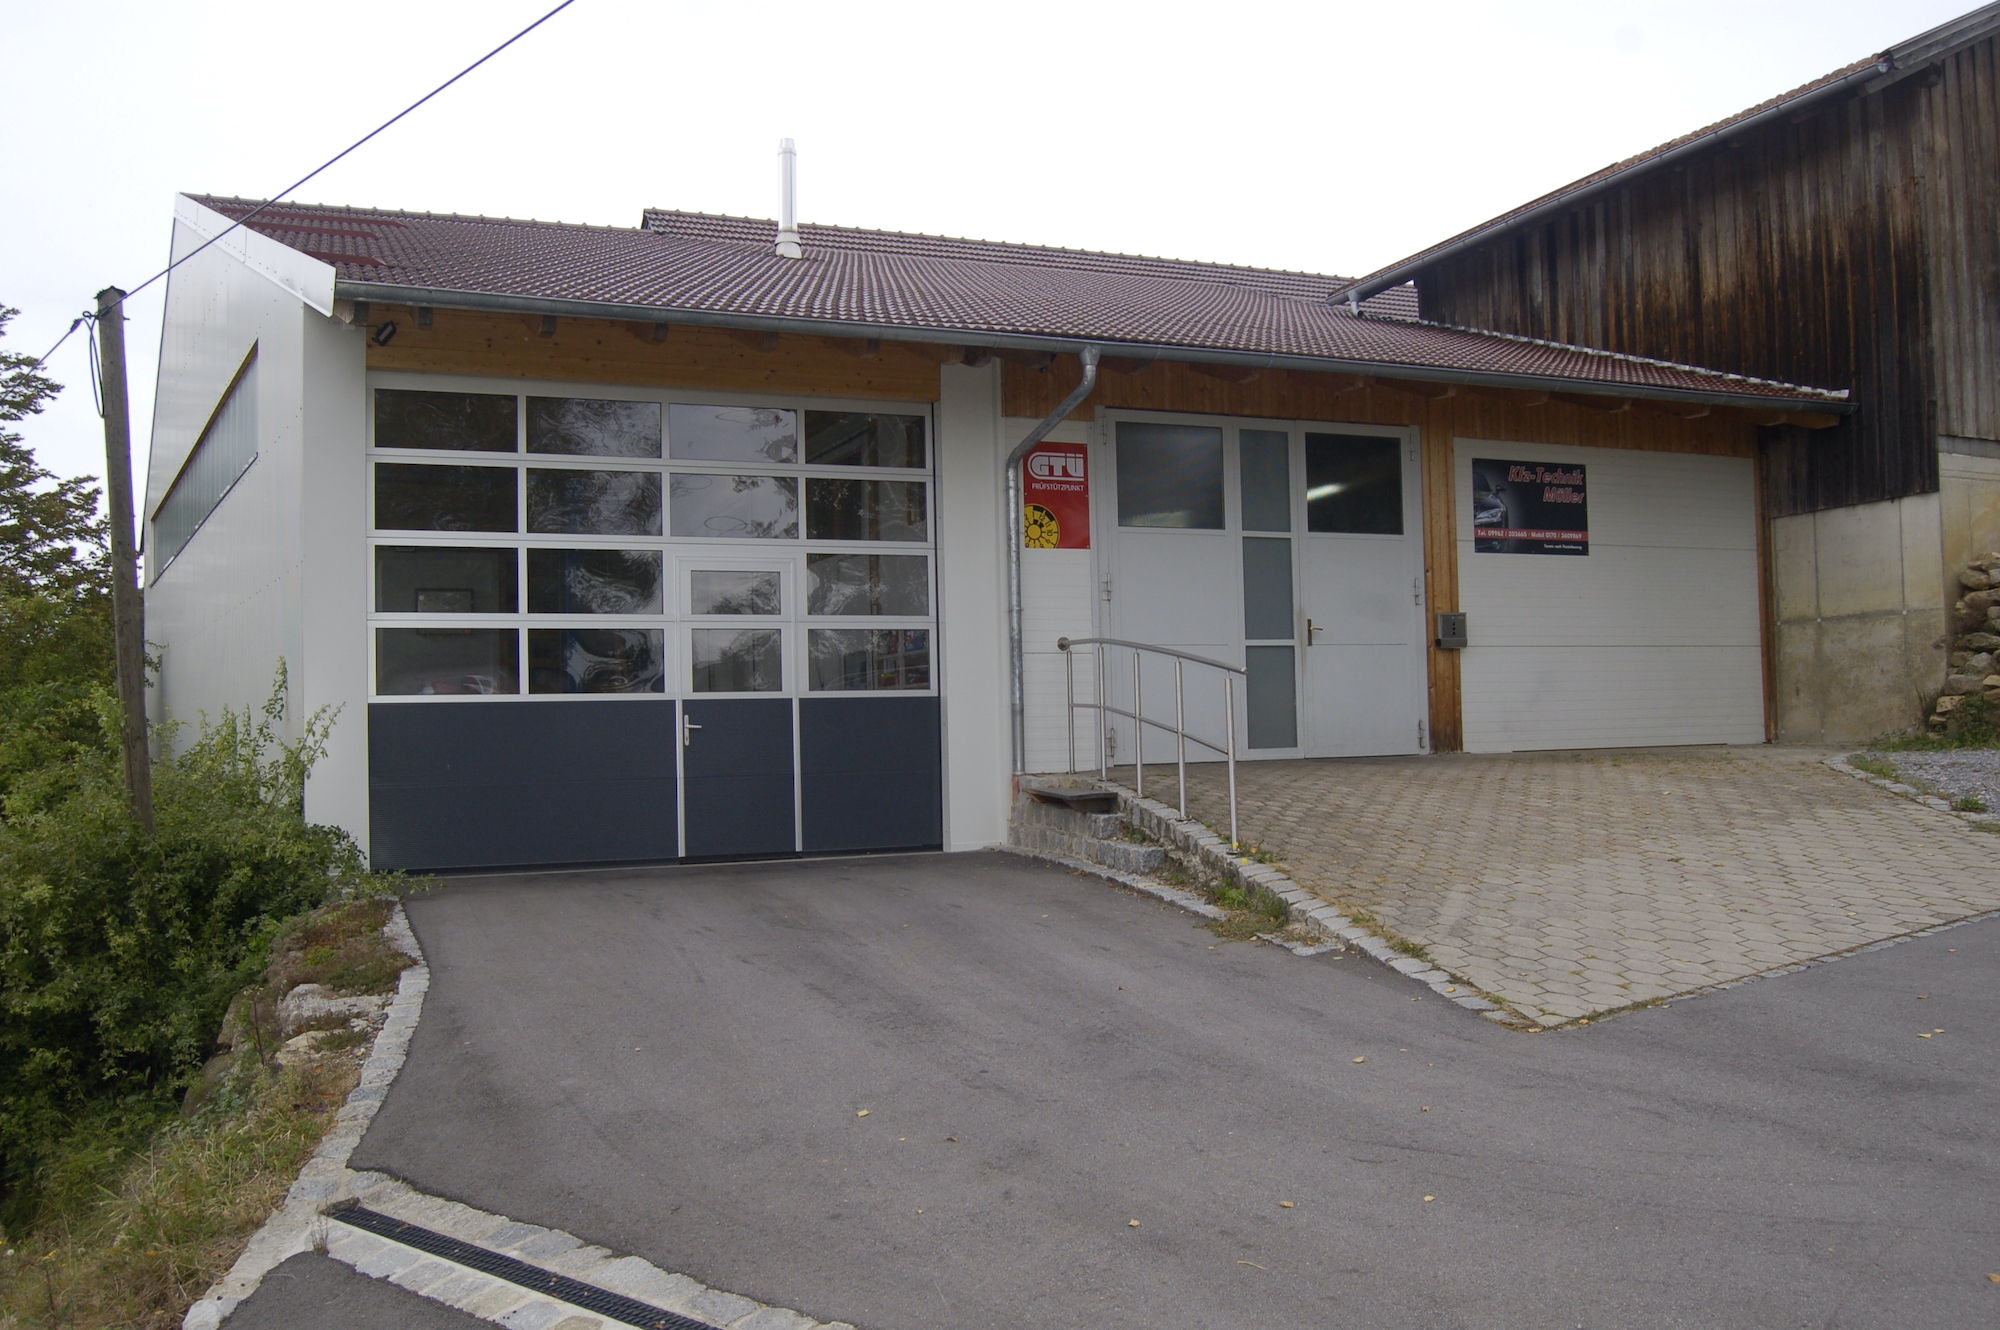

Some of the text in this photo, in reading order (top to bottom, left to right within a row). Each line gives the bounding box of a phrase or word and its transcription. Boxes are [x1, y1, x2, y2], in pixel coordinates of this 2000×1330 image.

[1028, 452, 1084, 480] GTÜ
[1508, 466, 1583, 485] Kfz-Technik
[1032, 483, 1084, 491] PRÜFSTÜTZPUNKT
